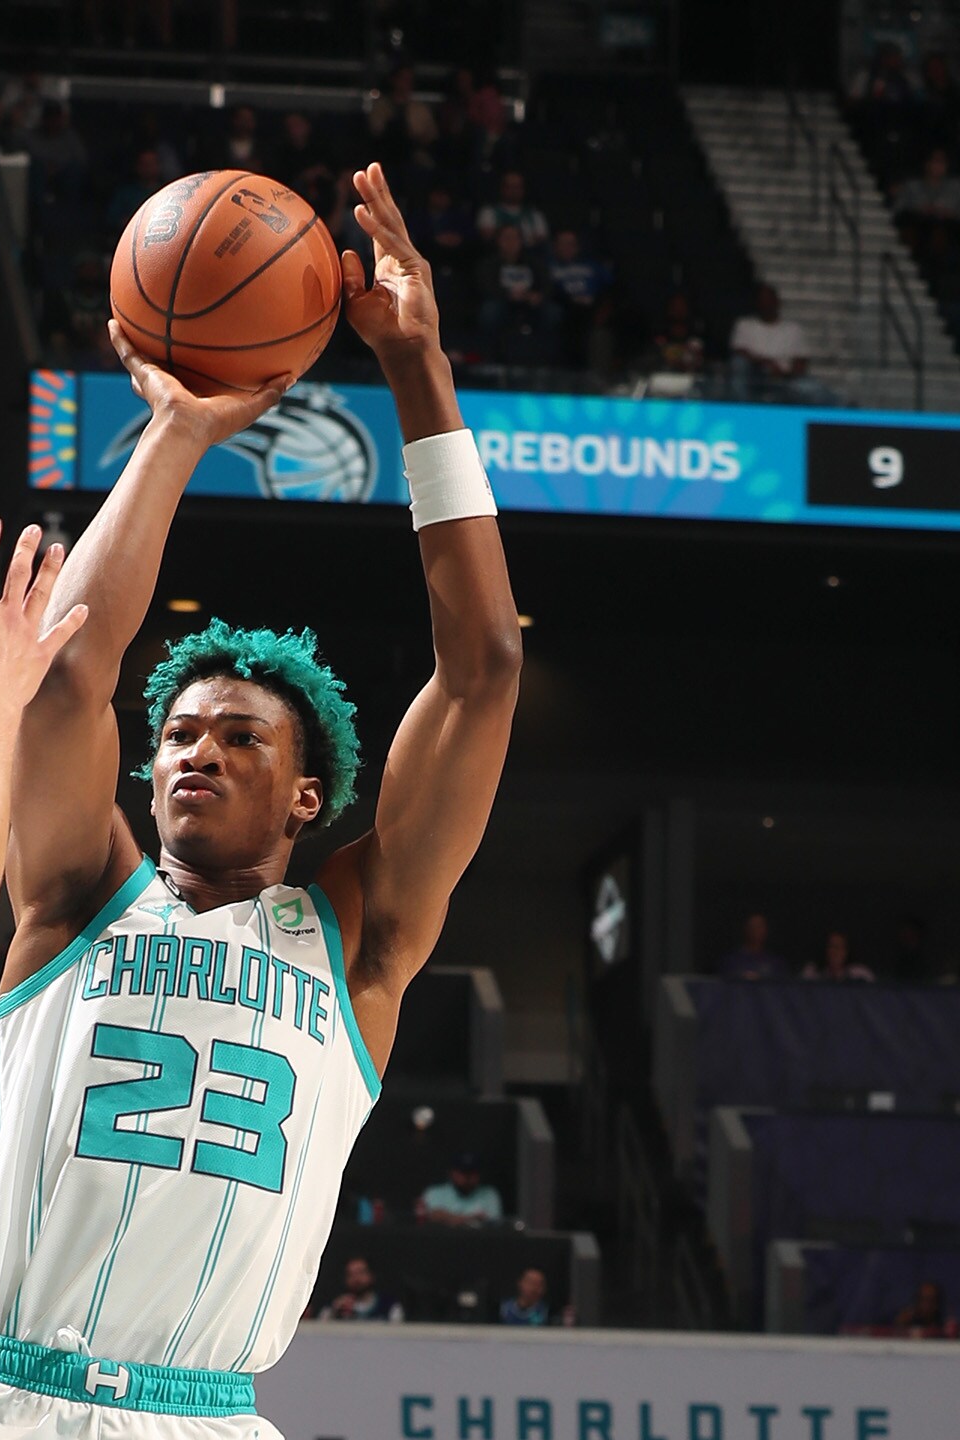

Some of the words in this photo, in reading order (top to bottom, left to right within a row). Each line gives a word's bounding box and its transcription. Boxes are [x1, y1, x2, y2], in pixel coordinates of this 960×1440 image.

[478, 431, 740, 482] REBOUNDS
[868, 446, 904, 489] 9
[82, 935, 330, 1046] CHARLOTTE
[74, 1022, 297, 1195] 23
